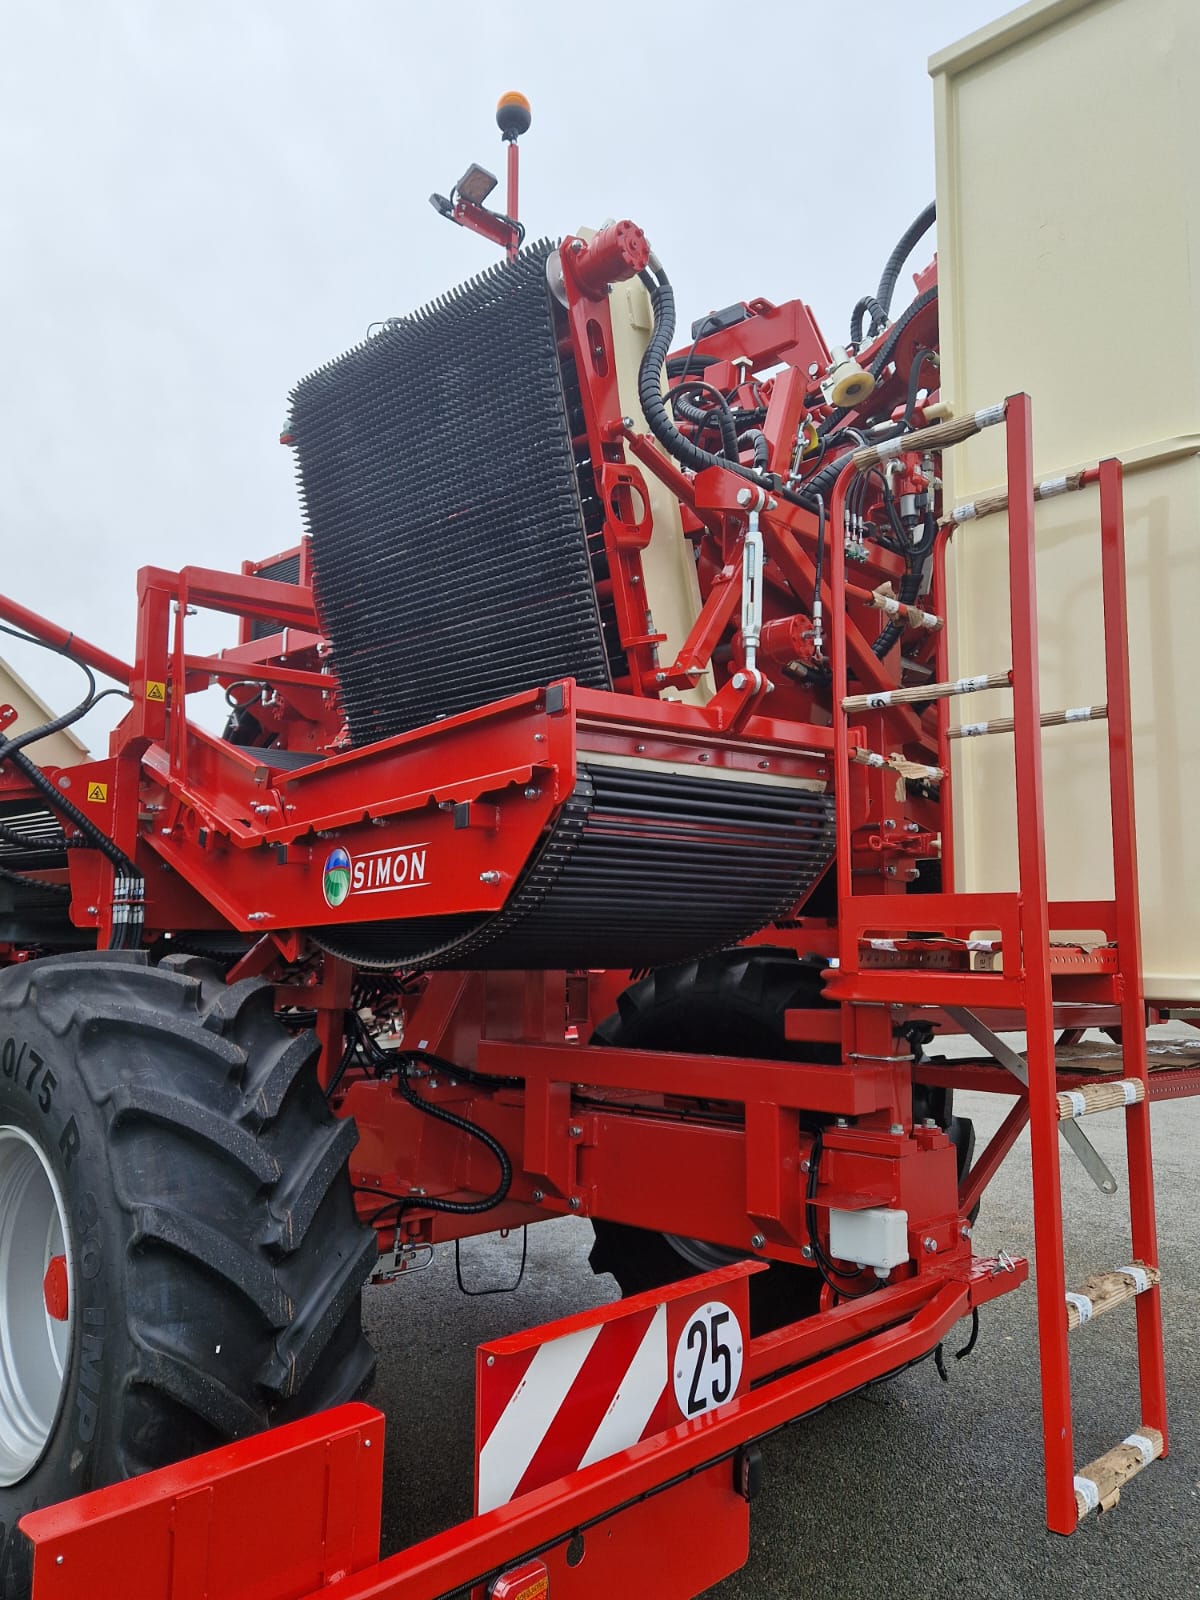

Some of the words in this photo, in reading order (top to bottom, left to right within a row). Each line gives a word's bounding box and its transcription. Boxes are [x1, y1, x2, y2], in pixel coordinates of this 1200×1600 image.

[352, 849, 426, 889] SIMON
[59, 1114, 80, 1170] R
[687, 1311, 731, 1415] 25
